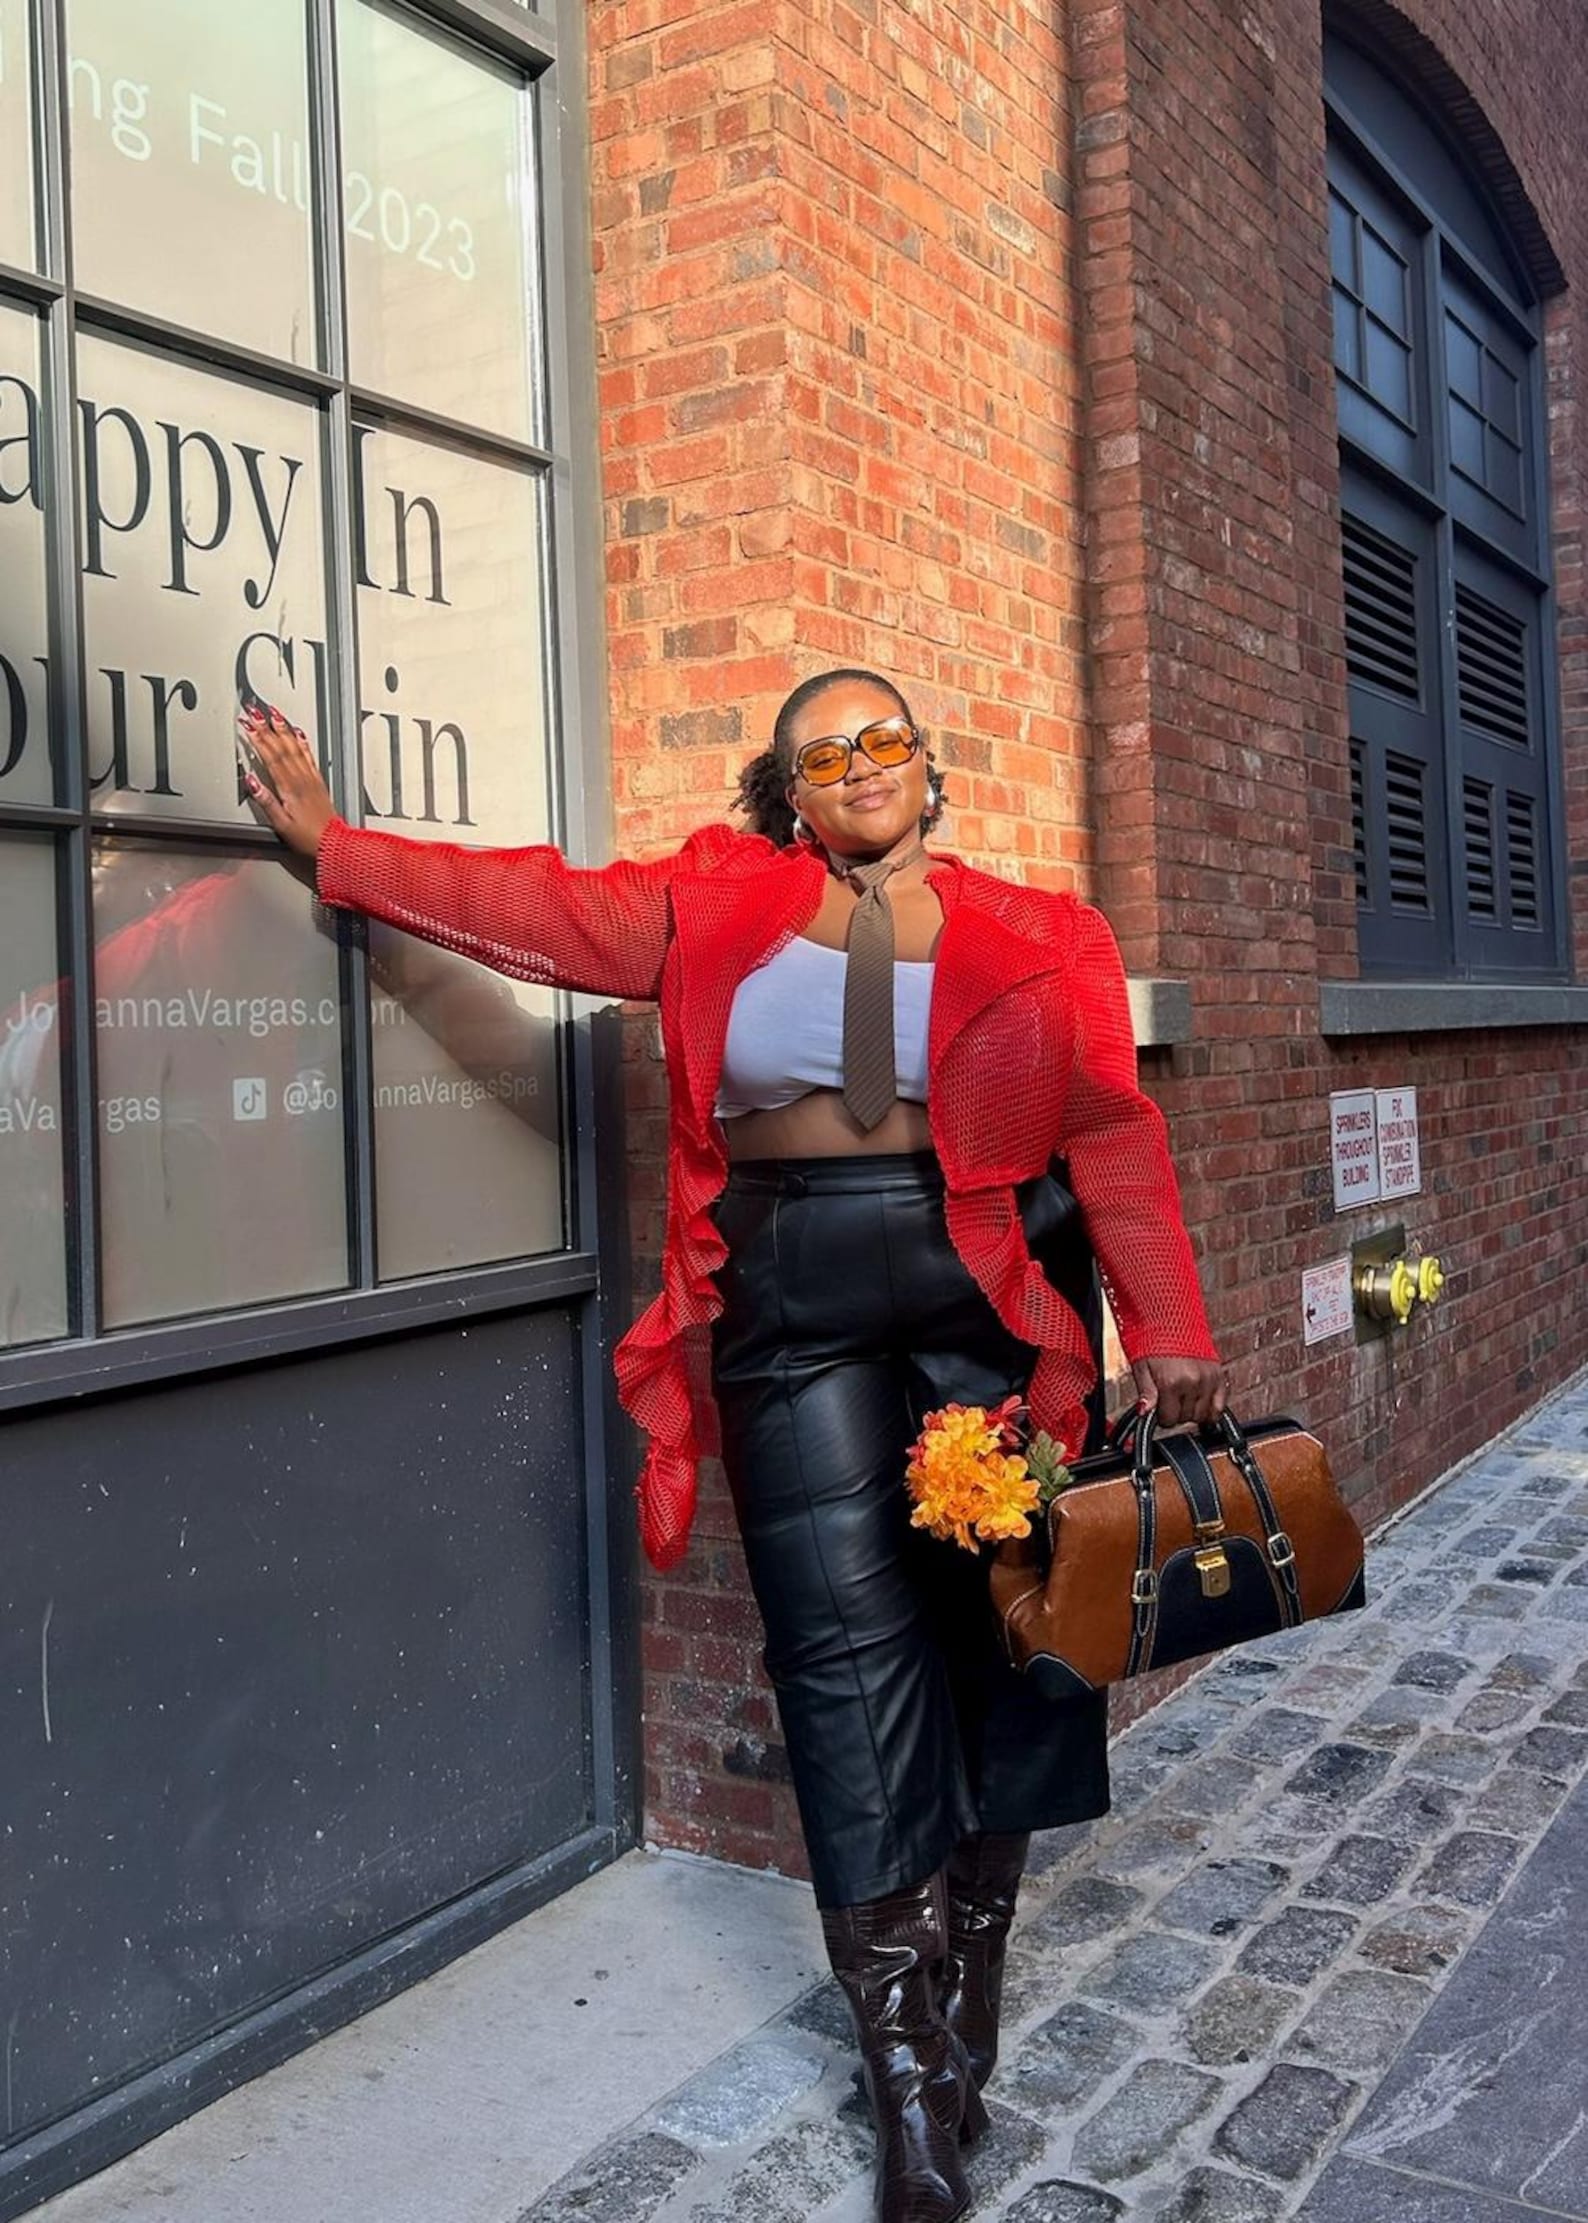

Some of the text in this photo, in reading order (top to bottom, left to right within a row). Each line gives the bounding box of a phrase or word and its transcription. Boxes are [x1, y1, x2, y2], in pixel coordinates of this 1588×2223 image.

[188, 92, 307, 212] Fall
[345, 170, 477, 281] 2023
[351, 423, 452, 606] In
[283, 1070, 540, 1116] @JonnaVargasSpa
[1335, 1136, 1374, 1161] THROUGHOUT
[1343, 1163, 1370, 1188] BUILDING
